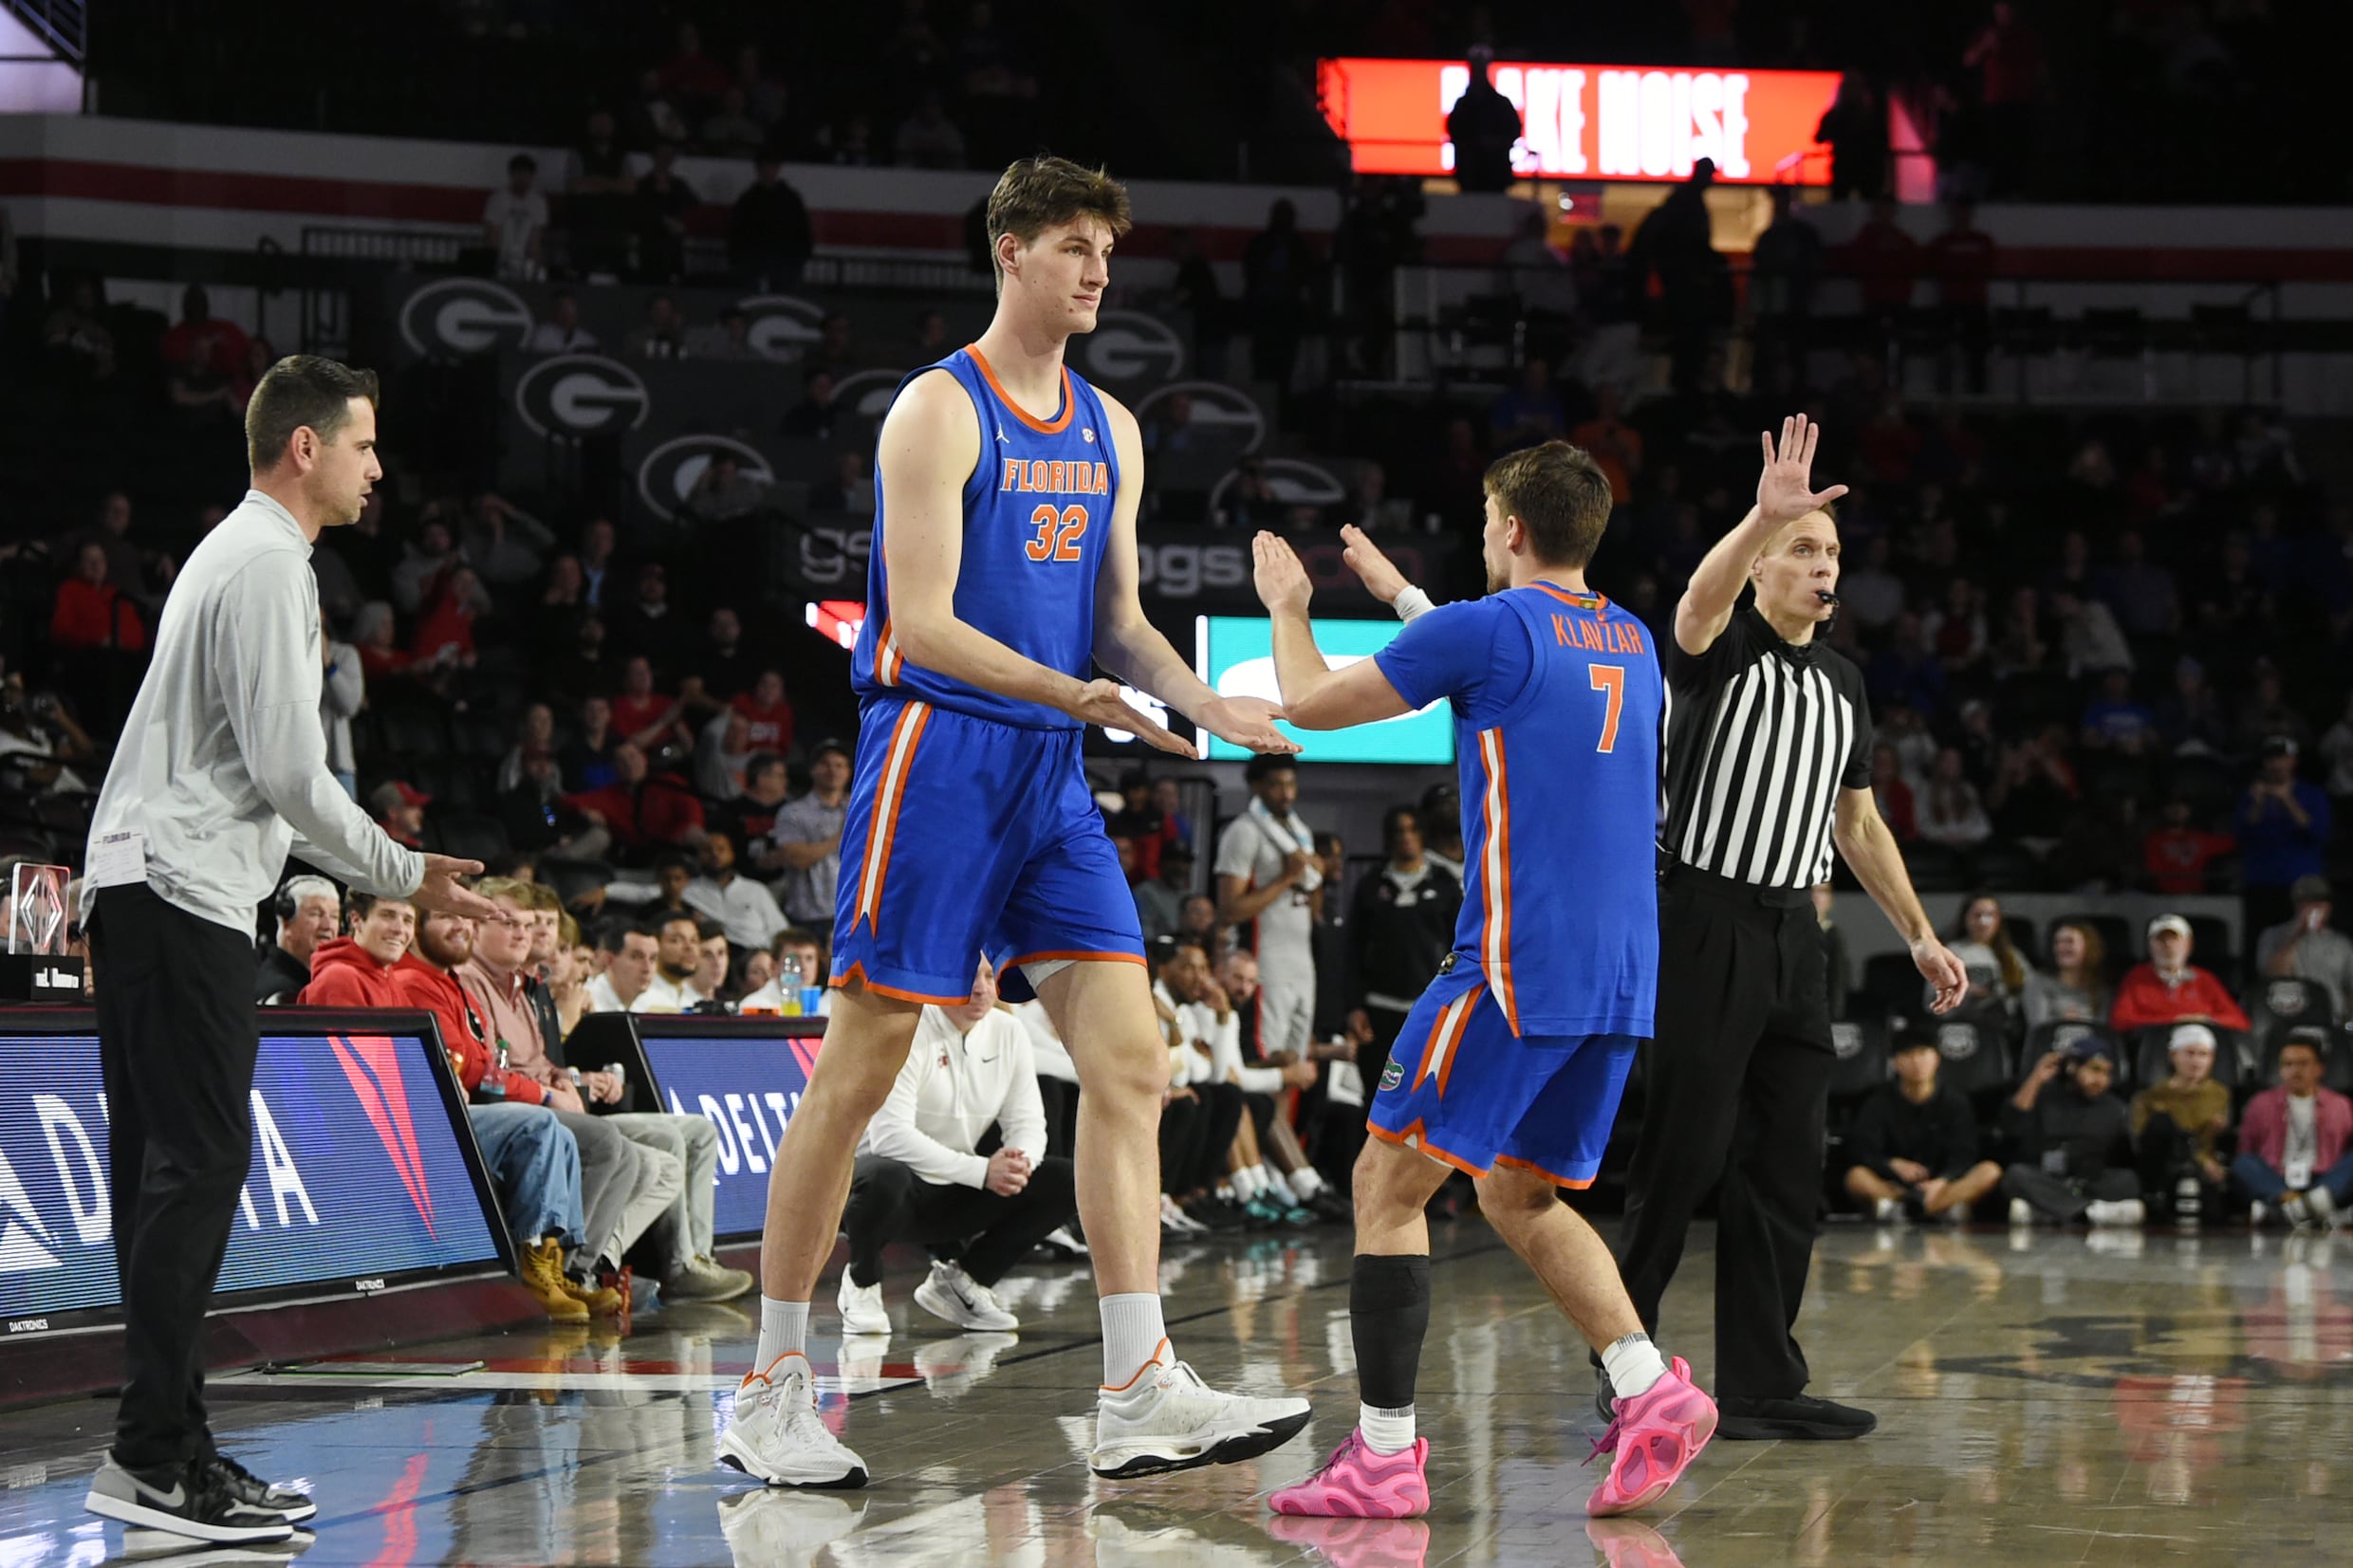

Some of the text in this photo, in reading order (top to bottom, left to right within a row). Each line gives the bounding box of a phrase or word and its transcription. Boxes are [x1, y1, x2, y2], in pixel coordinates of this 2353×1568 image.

[1000, 457, 1108, 495] FLORIDA
[1025, 504, 1089, 562] 32
[1588, 663, 1624, 753] 7
[697, 1091, 802, 1175] DELT
